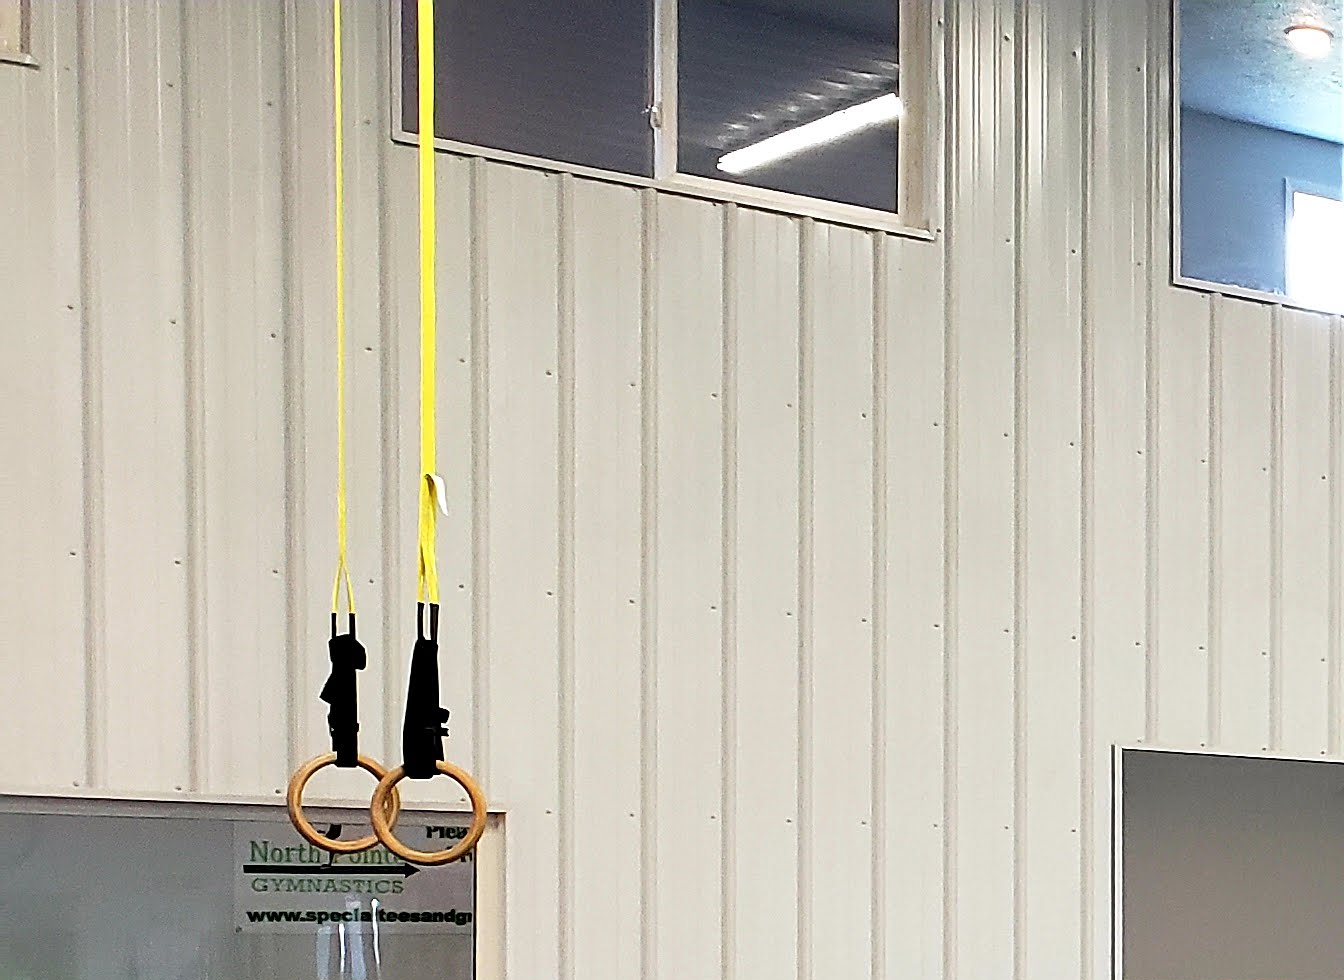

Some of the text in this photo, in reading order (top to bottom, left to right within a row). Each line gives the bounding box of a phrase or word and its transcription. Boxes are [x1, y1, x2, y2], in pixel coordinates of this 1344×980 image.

[250, 840, 321, 863] North
[251, 877, 404, 893] GYMNASTICS
[246, 908, 472, 926] www.speciateesandg
